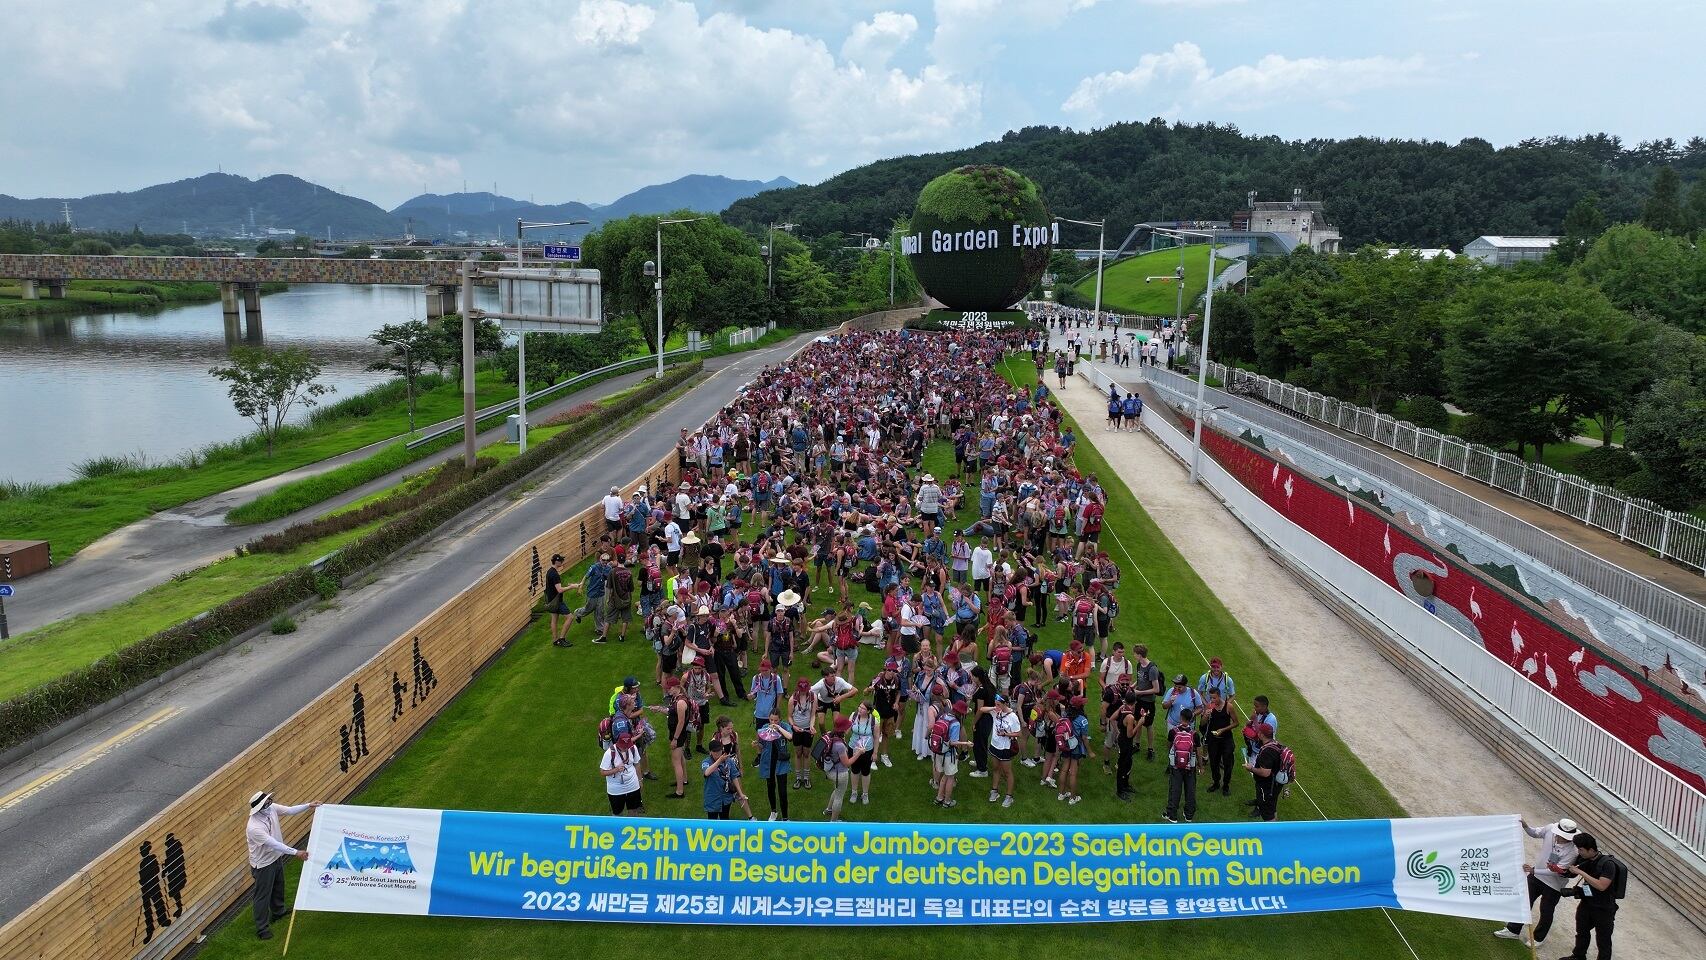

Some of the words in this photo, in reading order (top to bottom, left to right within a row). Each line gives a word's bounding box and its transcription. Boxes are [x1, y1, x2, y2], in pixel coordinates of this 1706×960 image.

[932, 229, 998, 253] Garden
[1012, 224, 1048, 249] Expo
[961, 311, 988, 321] 2023
[565, 826, 614, 849] The
[621, 827, 678, 850] 25th
[685, 828, 762, 852] World
[770, 830, 846, 854] Scout
[852, 831, 1065, 856] Jamboree-2023
[1072, 832, 1262, 856] SaeManGeum
[1460, 848, 1489, 859] 2023
[1460, 861, 1490, 871] 순천만
[469, 851, 515, 876] Wir
[521, 853, 647, 885] begrüßen
[655, 857, 722, 881] Ihren
[729, 858, 827, 883] Besuch
[833, 861, 879, 884] der
[885, 860, 1026, 885] deutschen
[1033, 861, 1180, 893] Delegation
[1187, 861, 1220, 886] im
[1226, 860, 1361, 885] Suncheon
[1460, 873, 1501, 883] 국제정원
[1461, 885, 1492, 896] 박람회
[522, 891, 581, 911] 2023
[586, 893, 649, 914] 새만금
[654, 894, 724, 916] 제25회
[731, 895, 916, 918] 세계스카우트잼버리
[923, 898, 964, 918] 독일
[971, 898, 1052, 918] 대표단의
[1059, 899, 1101, 917] 순천
[1106, 898, 1169, 916] 방문을
[1175, 895, 1288, 913] 환영합니다!
